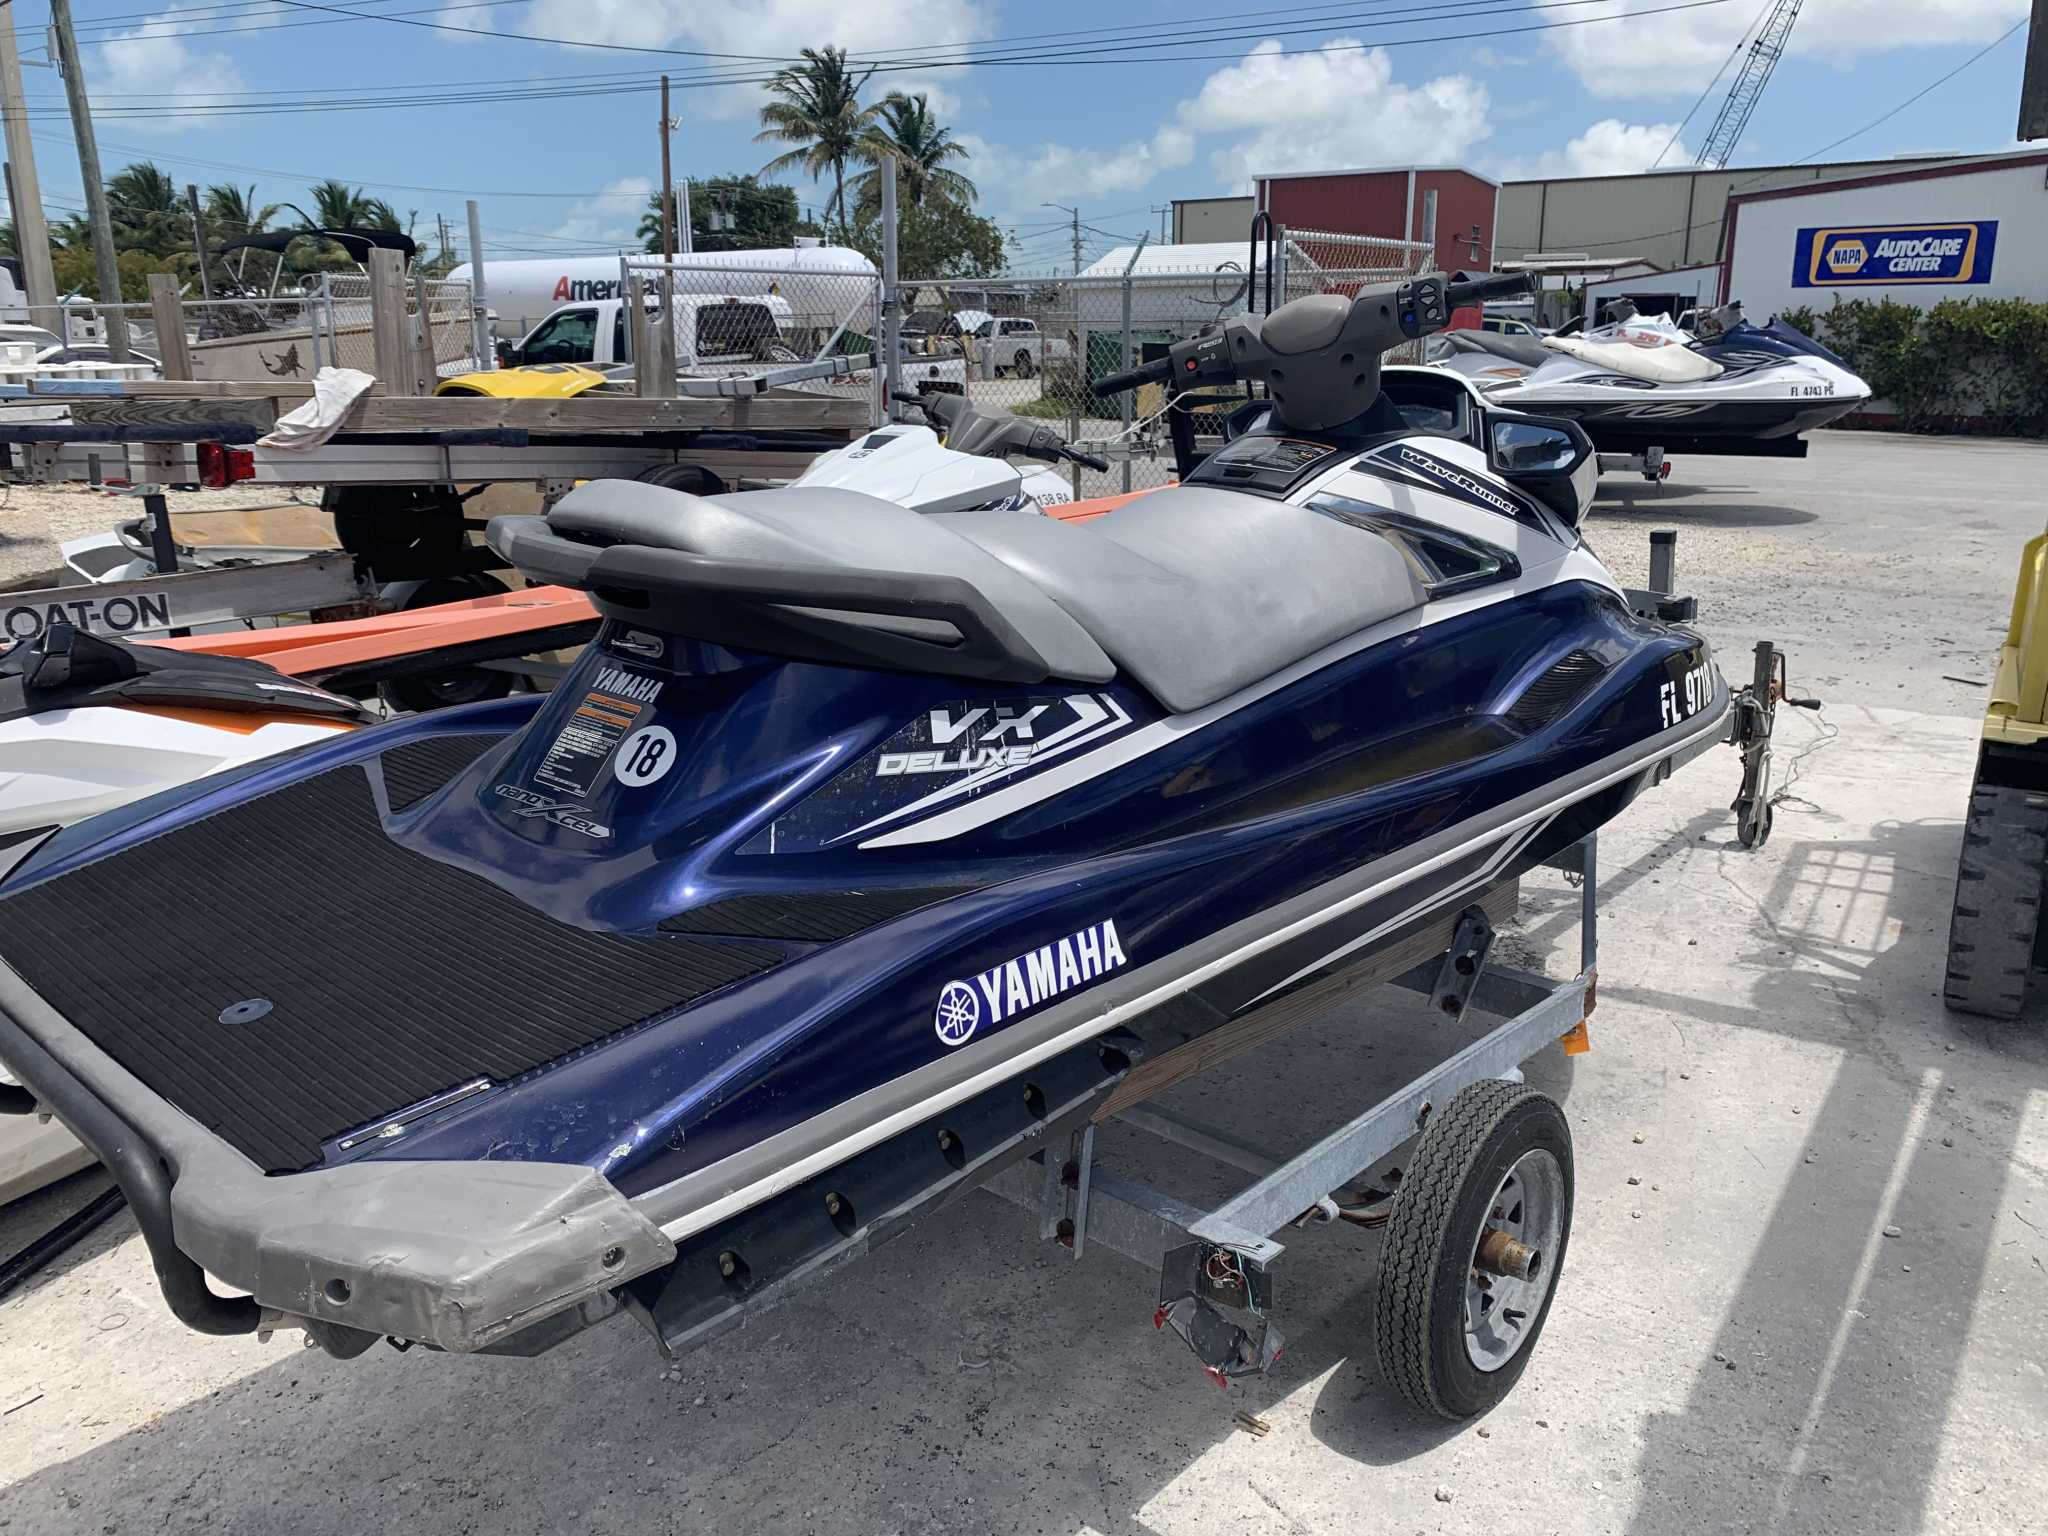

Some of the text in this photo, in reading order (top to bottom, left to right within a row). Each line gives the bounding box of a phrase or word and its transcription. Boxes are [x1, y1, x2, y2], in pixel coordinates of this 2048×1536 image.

[1832, 249, 1862, 265] NAPA
[1888, 257, 1941, 272] CENTER
[592, 667, 664, 703] YAMAHA
[1660, 680, 1682, 729] FL
[930, 705, 1050, 744] VX
[624, 734, 667, 778] 18
[875, 744, 1034, 776] DELUXE
[977, 917, 1127, 1024] YAMAHA
